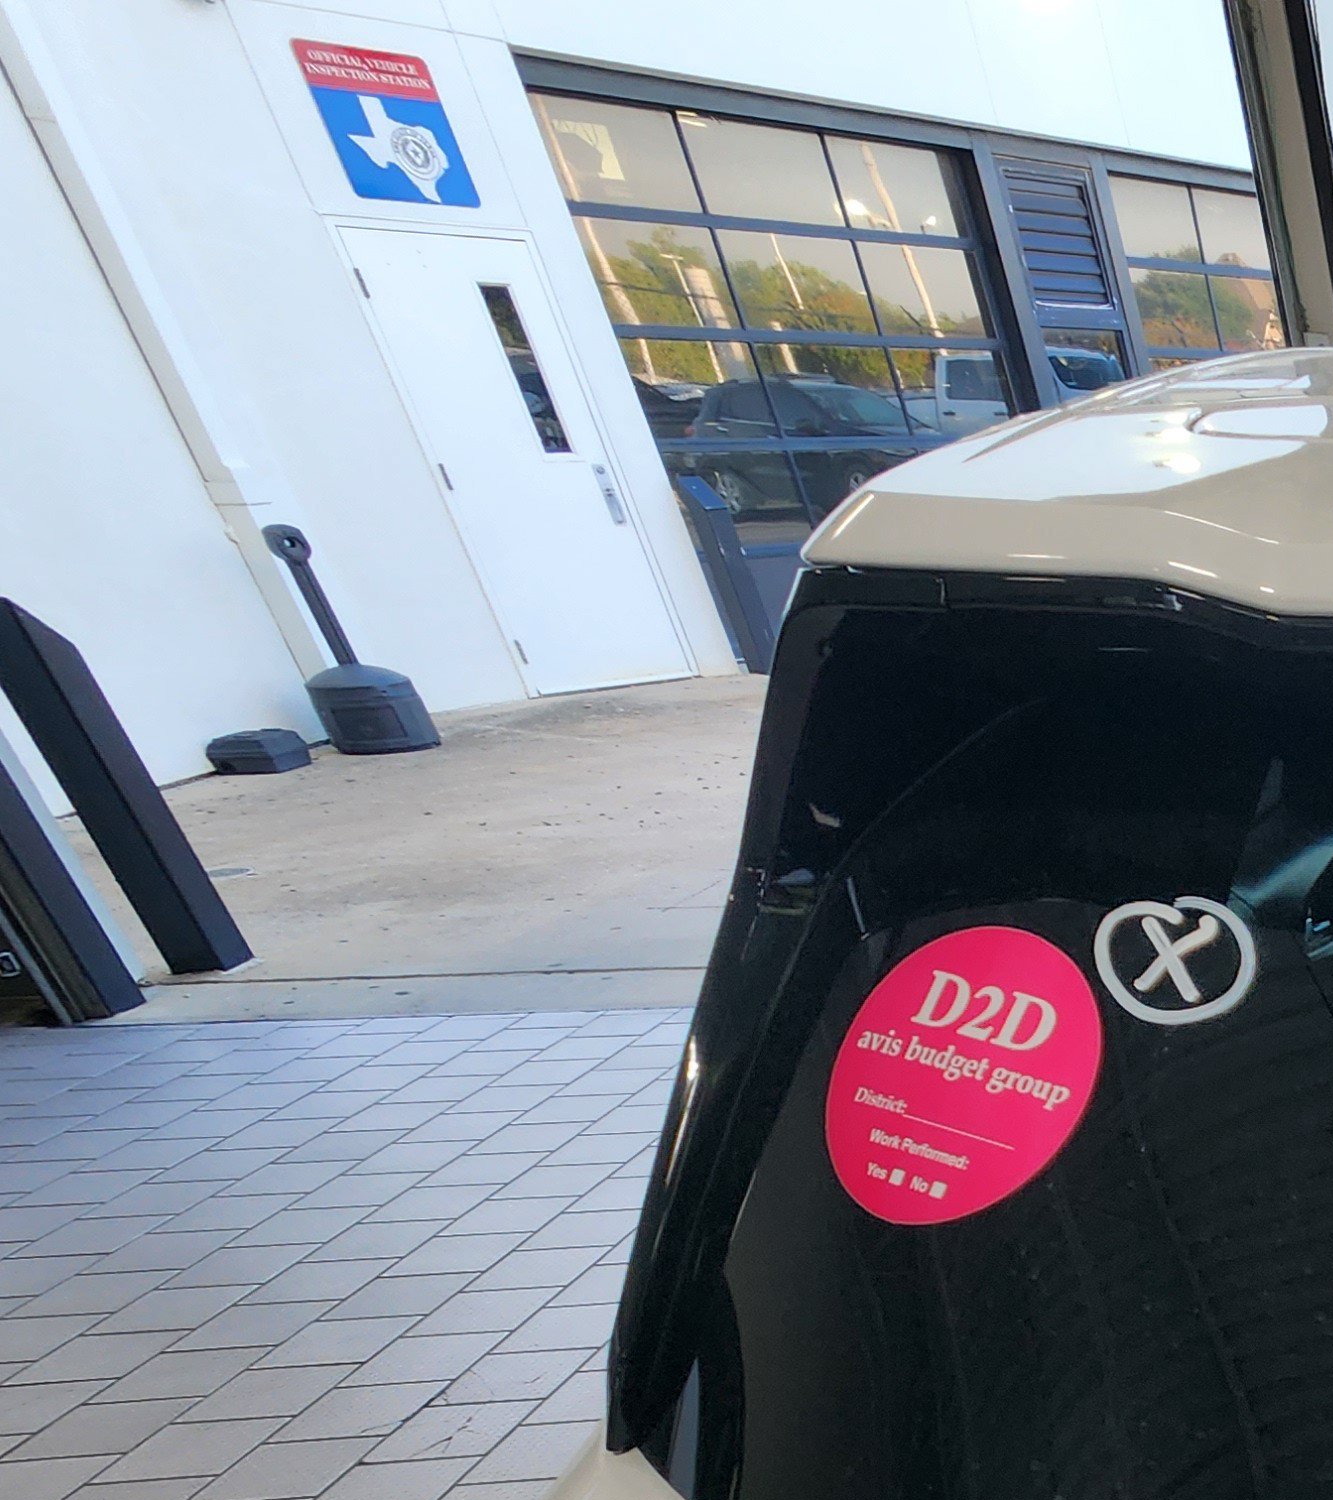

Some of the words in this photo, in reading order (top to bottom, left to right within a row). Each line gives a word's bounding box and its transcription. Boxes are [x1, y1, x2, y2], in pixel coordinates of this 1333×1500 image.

[303, 61, 380, 82] INSPECTION
[380, 73, 431, 89] STATION
[306, 49, 364, 67] OFFICIAL
[364, 57, 418, 75] VEHICLE
[910, 968, 1058, 1051] D2D
[856, 1028, 903, 1057] avis
[904, 1035, 990, 1082] budget
[985, 1065, 1071, 1112] group
[854, 1086, 908, 1114] District:
[869, 1127, 901, 1150] Work
[900, 1136, 971, 1171] Performed:
[866, 1161, 888, 1181] Yes
[909, 1174, 929, 1194] No
